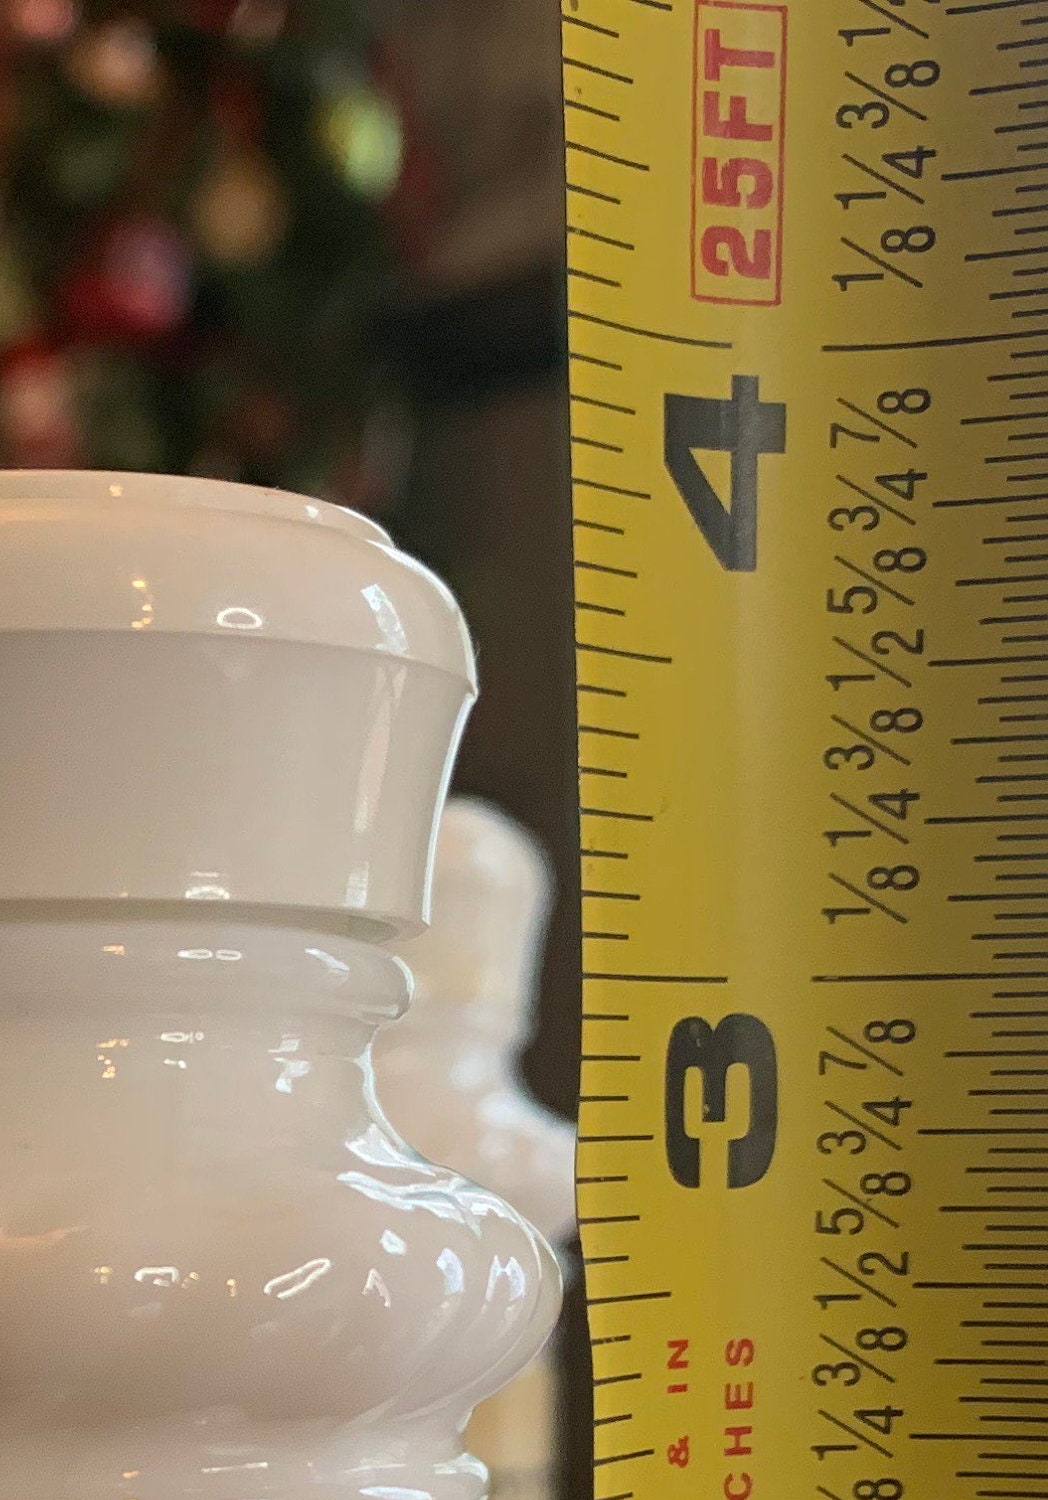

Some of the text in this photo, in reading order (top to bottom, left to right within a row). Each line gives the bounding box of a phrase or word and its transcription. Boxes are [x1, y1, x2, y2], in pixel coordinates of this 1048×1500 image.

[835, 59, 941, 129] 3/8
[700, 28, 776, 280] 25FT
[834, 145, 937, 210] 1/4
[832, 225, 936, 292] 1/8
[830, 388, 932, 448] 7/8
[664, 375, 787, 571] 4
[827, 467, 928, 531] 3/4
[826, 546, 927, 614] 5/8
[825, 629, 925, 691] 1/2
[823, 708, 924, 770] 3/8
[823, 788, 921, 847] 1/4
[821, 864, 921, 924] 1/8
[818, 1018, 917, 1076] 7/8
[664, 1013, 779, 1190] 3
[816, 1097, 913, 1155] 3/4
[815, 1171, 912, 1235] 5/8
[813, 1251, 910, 1310] 1/2
[666, 1338, 690, 1393] IN
[811, 1326, 909, 1387] 3/8
[667, 1436, 690, 1468] &
[810, 1406, 904, 1459] 1/4
